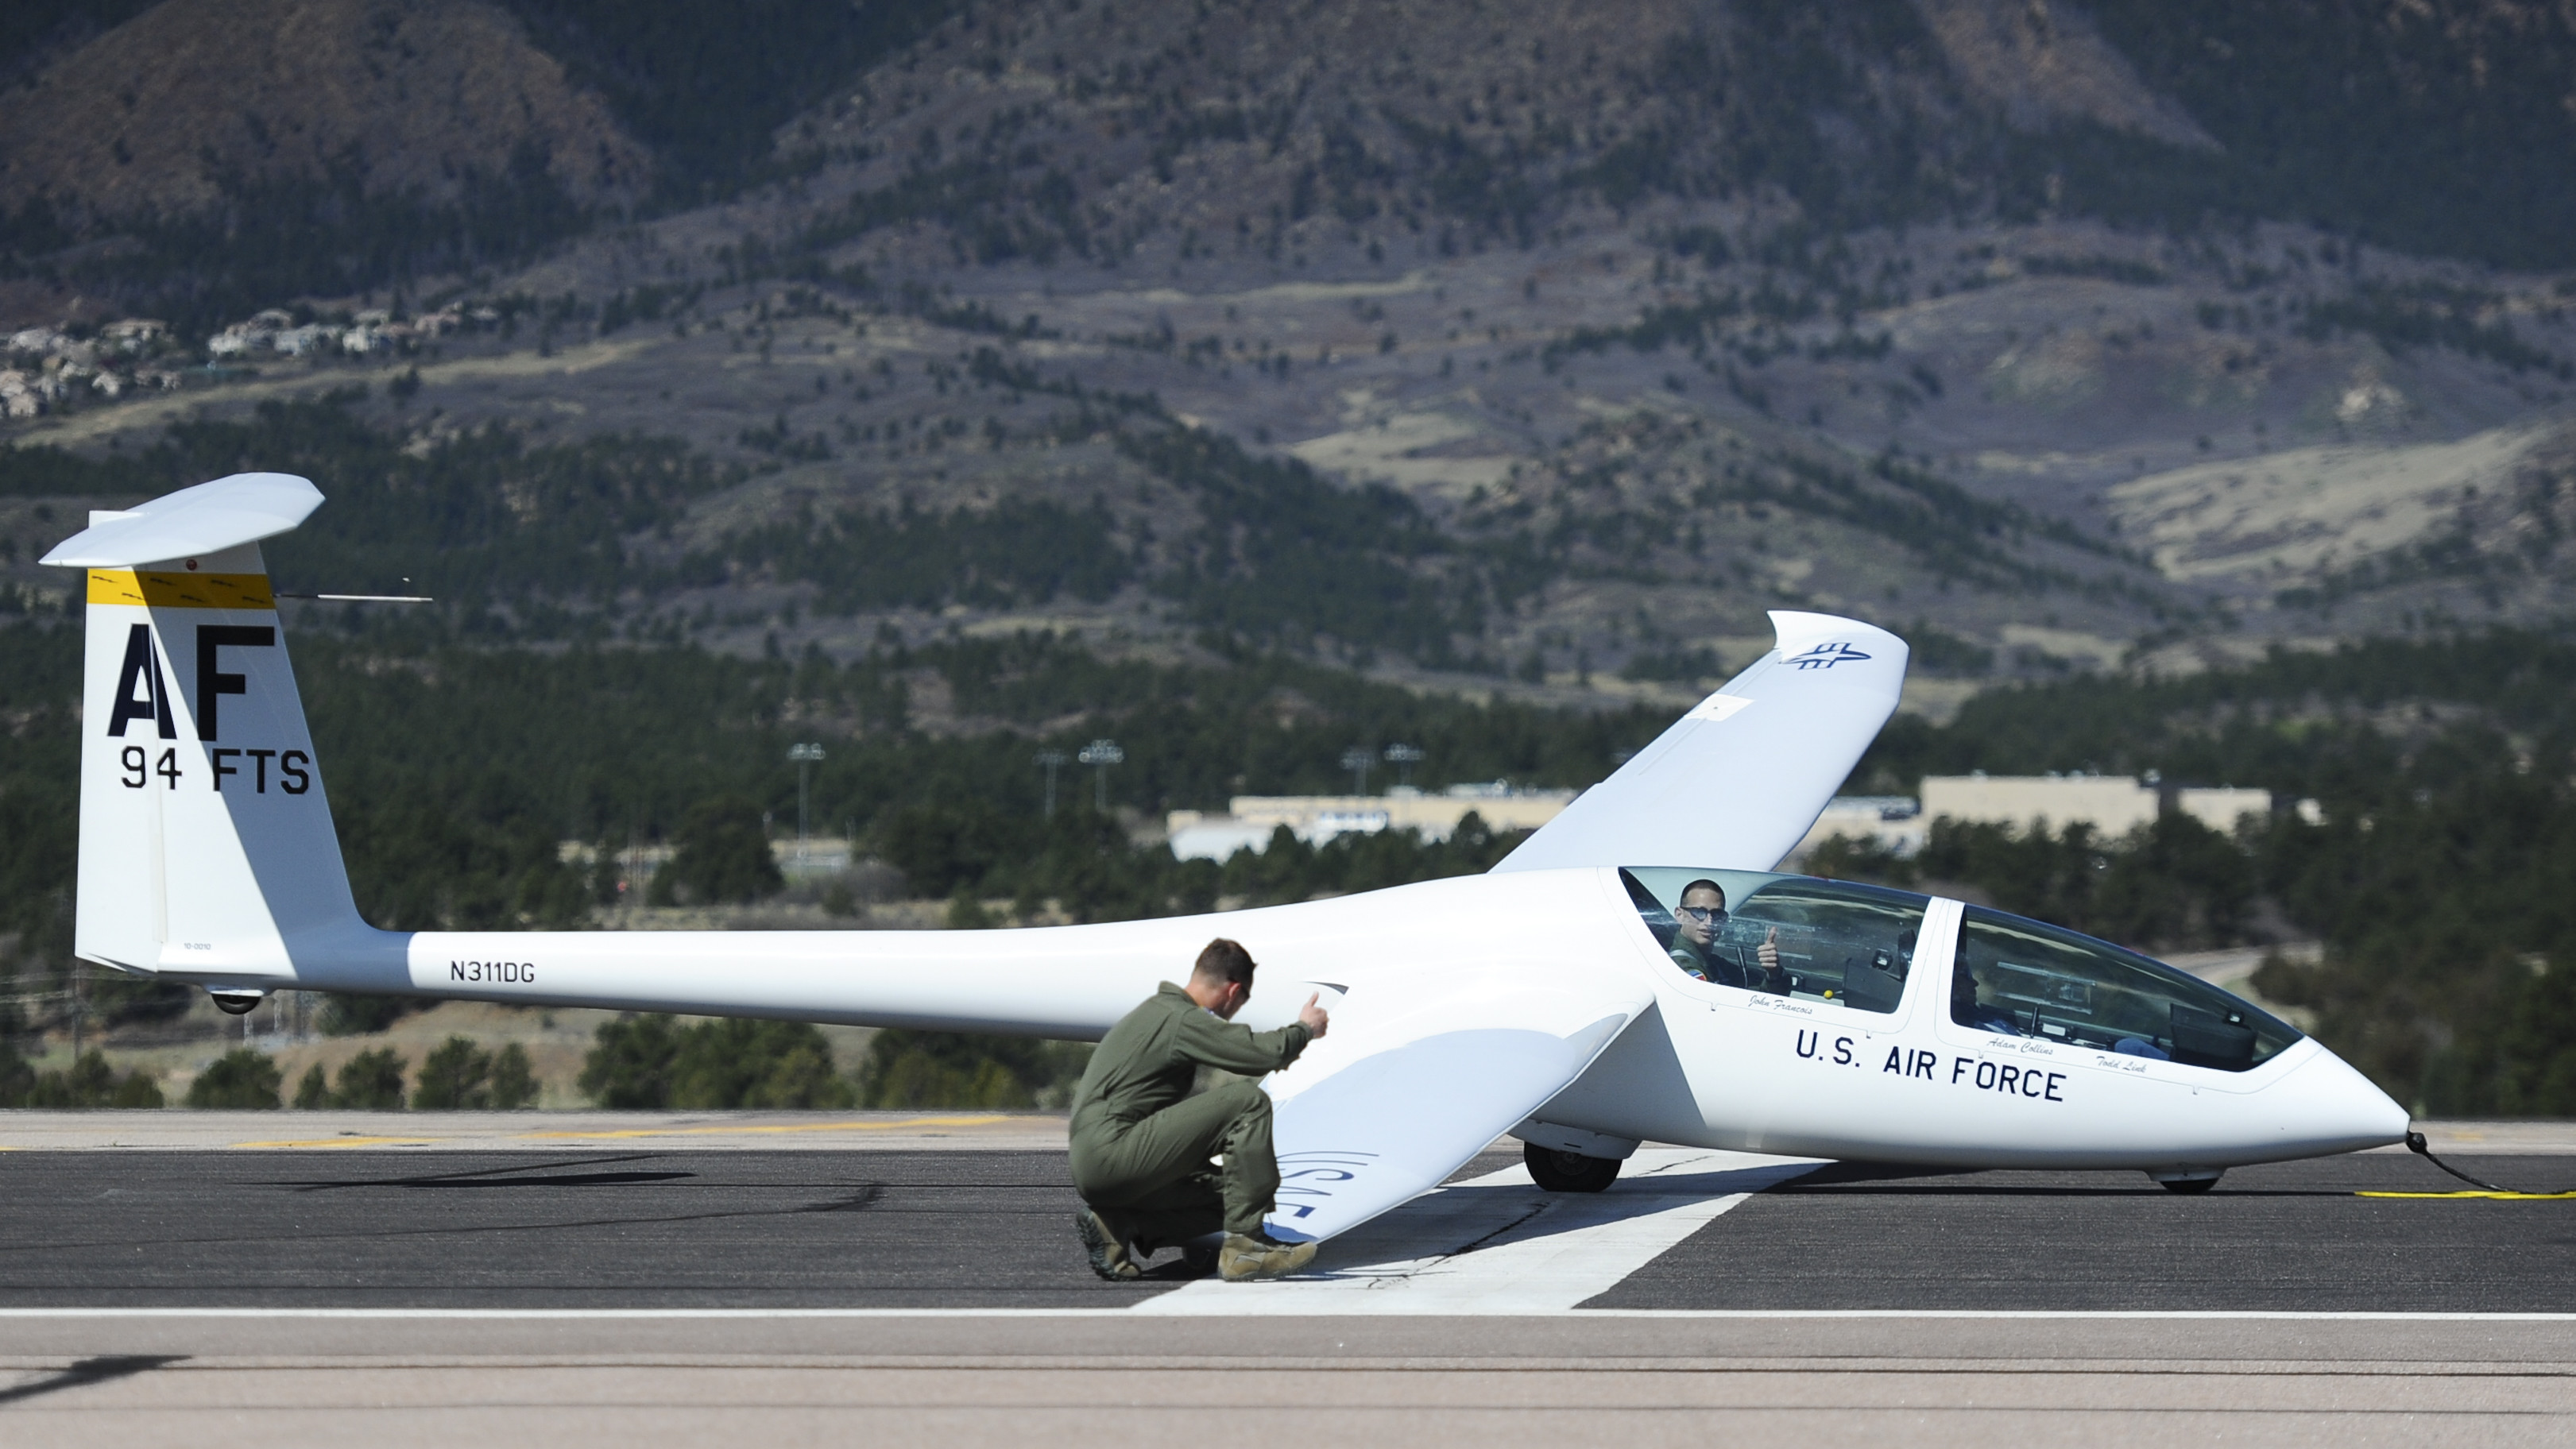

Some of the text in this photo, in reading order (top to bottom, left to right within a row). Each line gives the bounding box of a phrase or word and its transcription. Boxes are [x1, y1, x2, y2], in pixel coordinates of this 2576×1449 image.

[107, 624, 275, 742] AF
[122, 745, 310, 795] 94 FTS
[451, 960, 536, 983] N311DG
[1748, 995, 1770, 1007] John
[1986, 1037, 2054, 1055] Adam Collins
[1796, 1029, 2067, 1103] U.S. AIR FORCE
[2096, 1056, 2122, 1069] Todd
